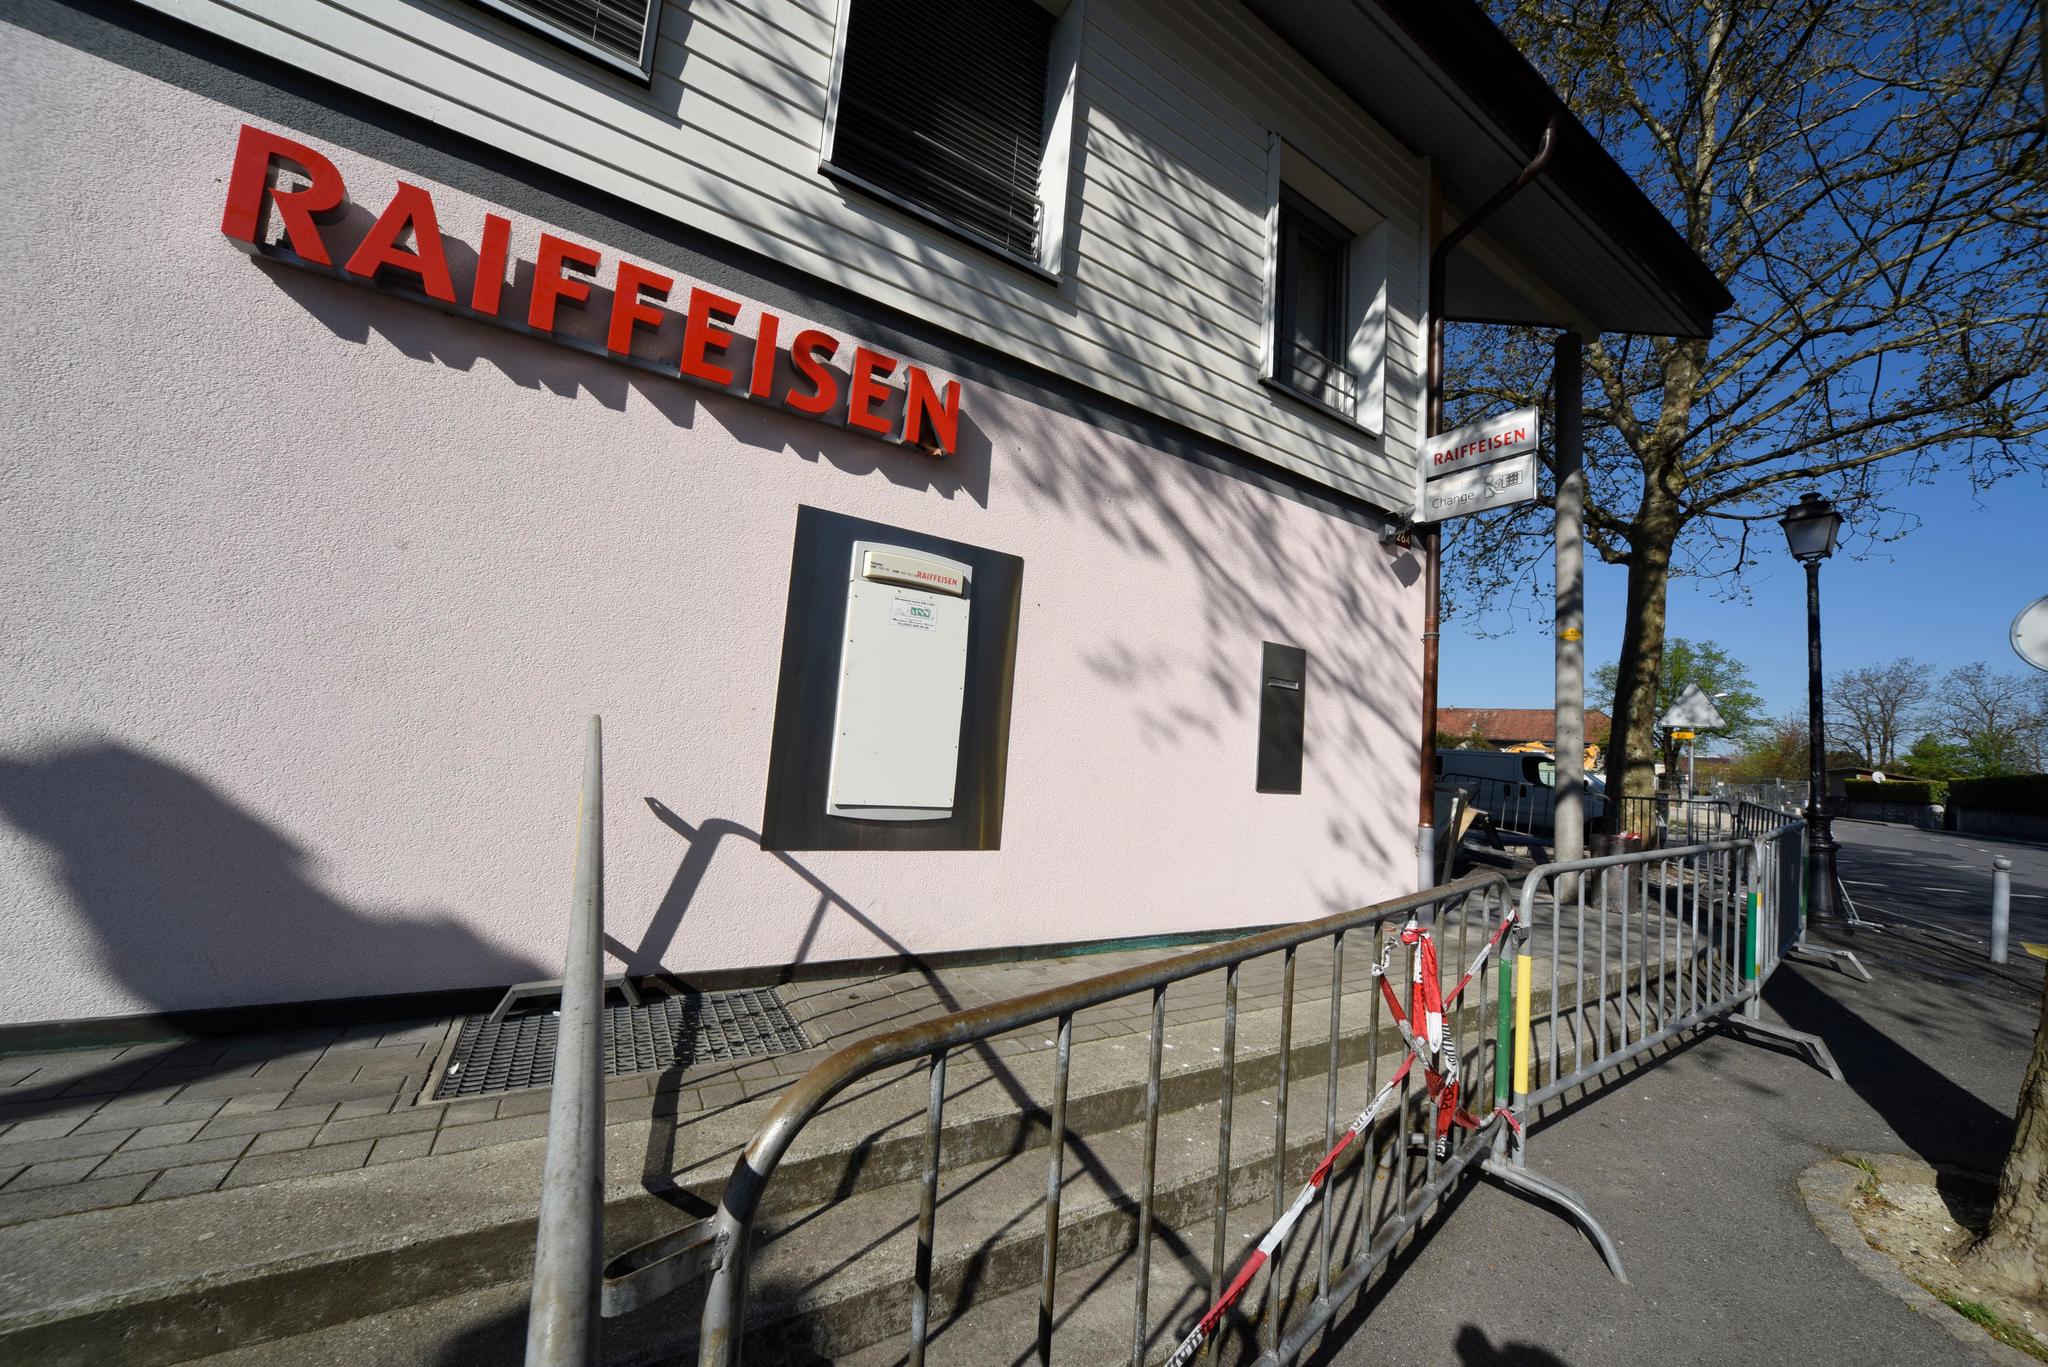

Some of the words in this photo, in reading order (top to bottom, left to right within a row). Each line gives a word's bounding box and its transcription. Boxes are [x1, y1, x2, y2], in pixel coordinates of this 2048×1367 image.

[221, 124, 961, 458] RAIFFEISEN
[1433, 428, 1526, 466] RAIFFEISEN
[1431, 493, 1475, 509] Change
[917, 570, 958, 586] RAIFFEISEN
